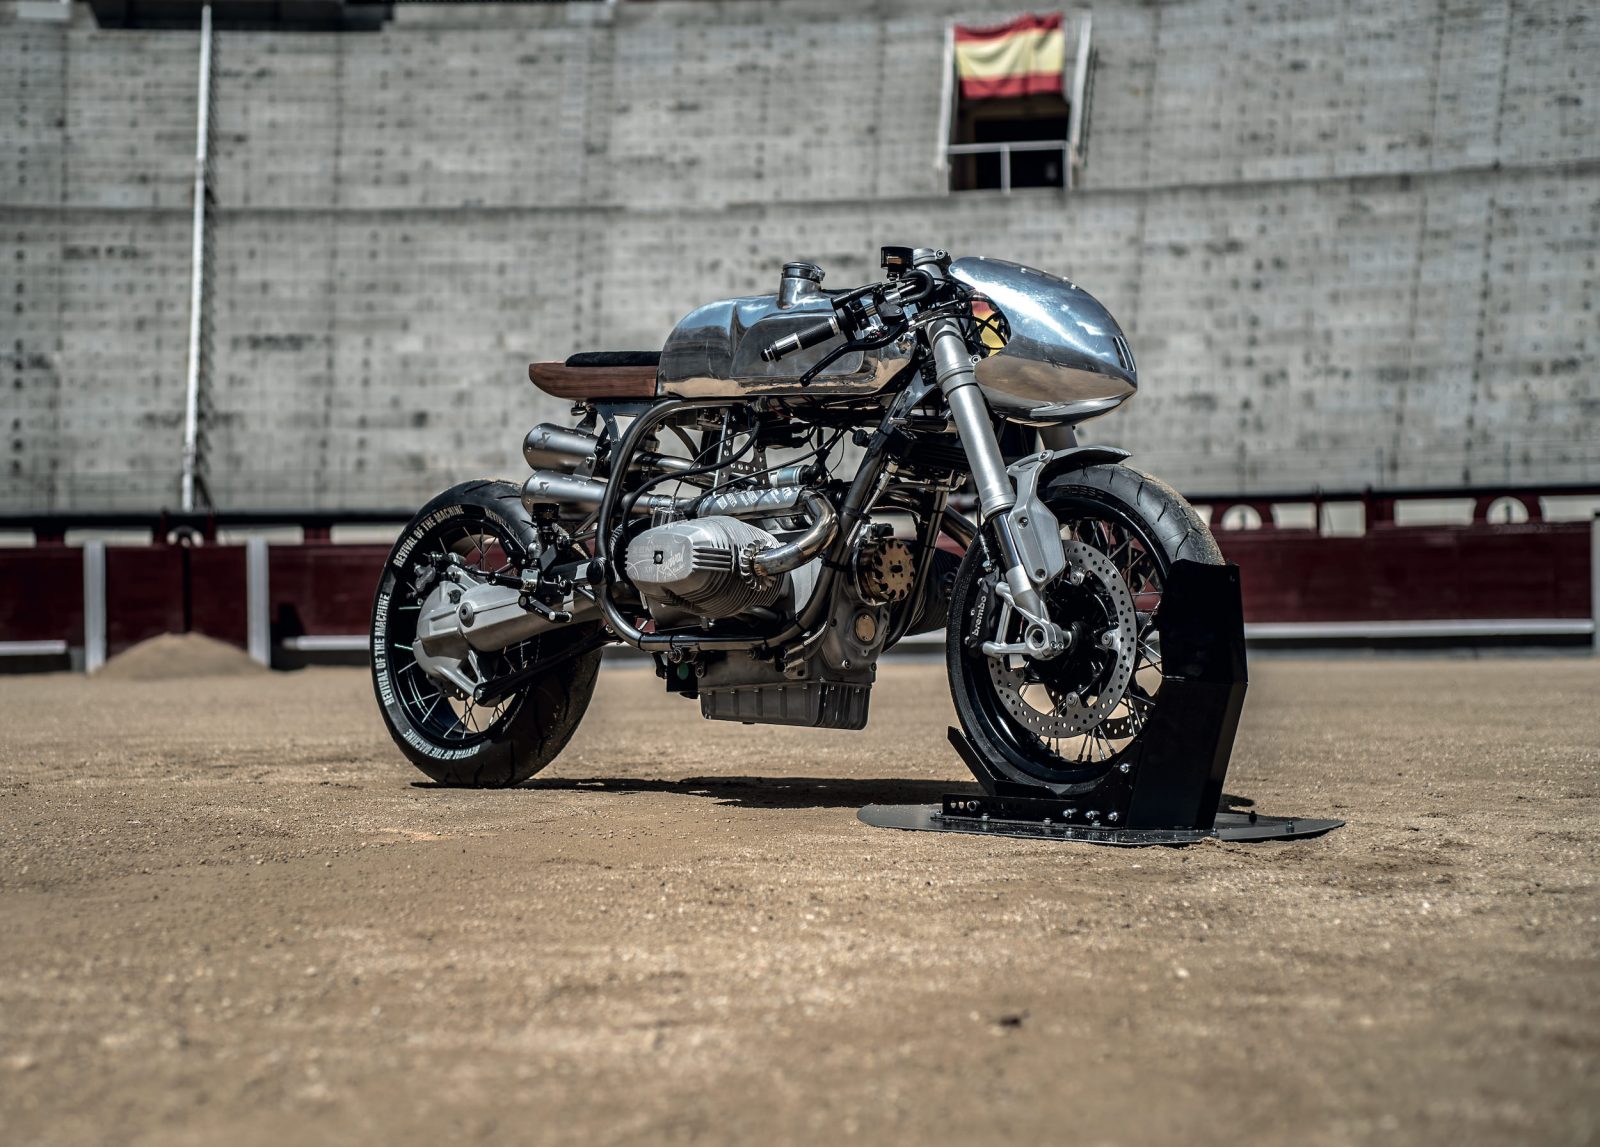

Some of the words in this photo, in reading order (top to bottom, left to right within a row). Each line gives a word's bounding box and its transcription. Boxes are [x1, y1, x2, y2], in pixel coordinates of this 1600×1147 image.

[393, 536, 418, 568] REVIVAL
[413, 526, 425, 539] OF
[420, 516, 437, 531] THE
[433, 504, 465, 523] MACHINE
[374, 592, 391, 637] MACHINE
[971, 595, 987, 636] brembo
[374, 637, 386, 657] THE
[375, 657, 387, 670] OF
[377, 669, 396, 707] REVIVAL
[403, 728, 434, 755] MACHINE
[429, 747, 445, 759] THE
[452, 744, 481, 760] REVIVAL
[442, 750, 454, 760] OF
